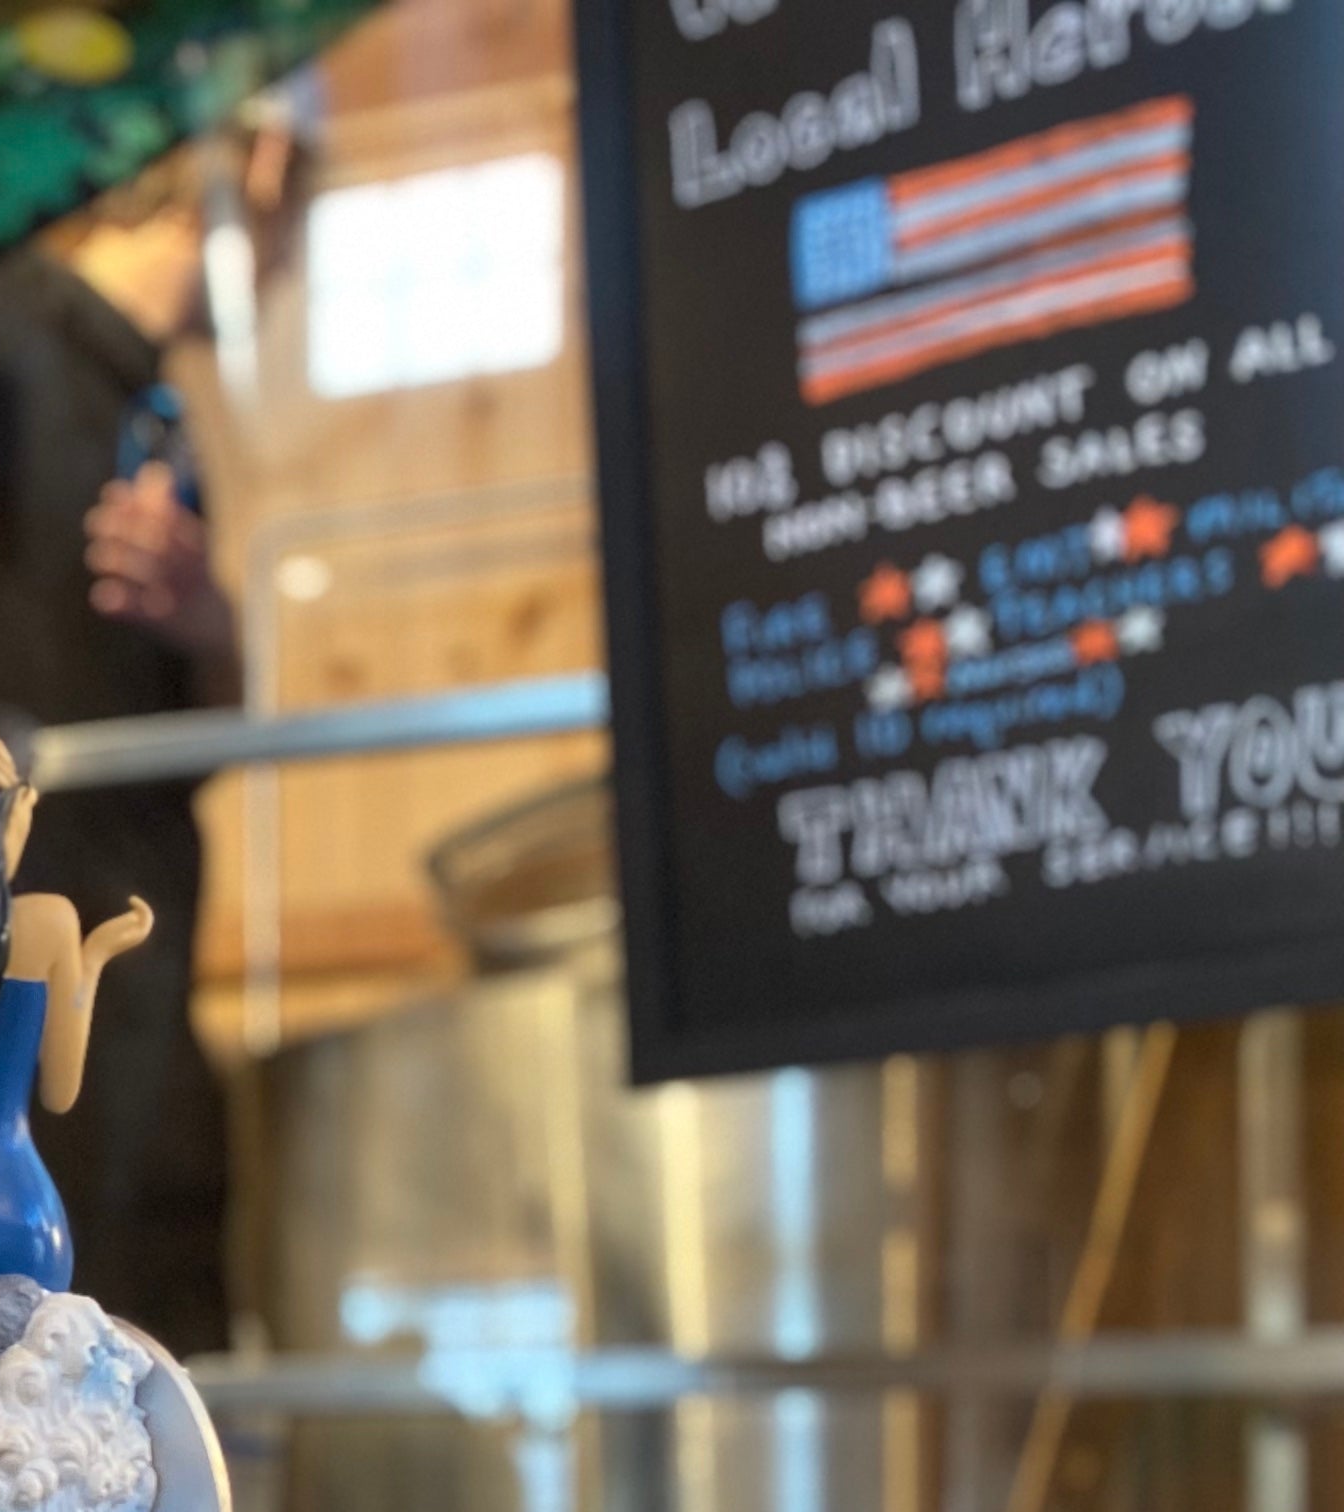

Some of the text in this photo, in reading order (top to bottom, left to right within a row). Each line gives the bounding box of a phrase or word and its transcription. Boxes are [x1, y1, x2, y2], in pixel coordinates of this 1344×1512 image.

[668, 17, 920, 209] Local
[821, 364, 1095, 486] DISCOUNT
[1125, 338, 1209, 406] ON
[1230, 312, 1335, 383] ALL
[1038, 408, 1205, 488] SALES
[776, 680, 1344, 887] THANK YOU
